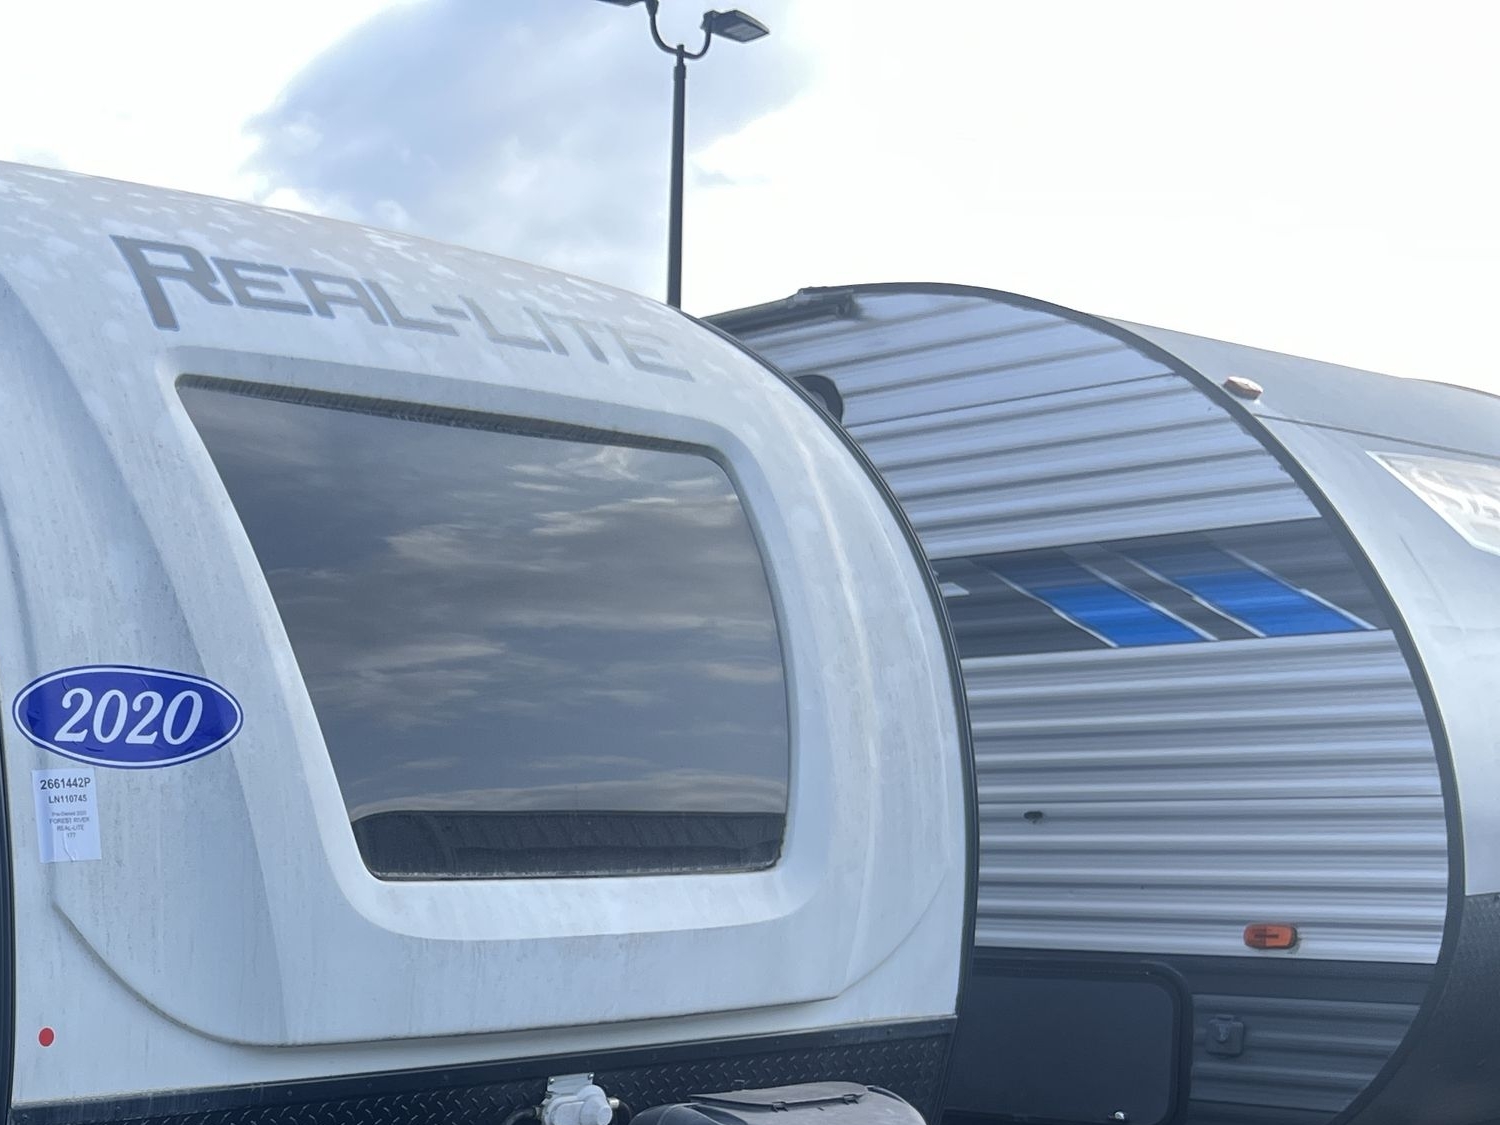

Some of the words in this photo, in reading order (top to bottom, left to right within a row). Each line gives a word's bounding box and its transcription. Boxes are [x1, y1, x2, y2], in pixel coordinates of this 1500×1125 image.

[110, 234, 696, 383] REAL-LITE
[54, 687, 203, 745] 2020
[40, 777, 91, 790] 2661442P
[48, 794, 88, 804] LN110745
